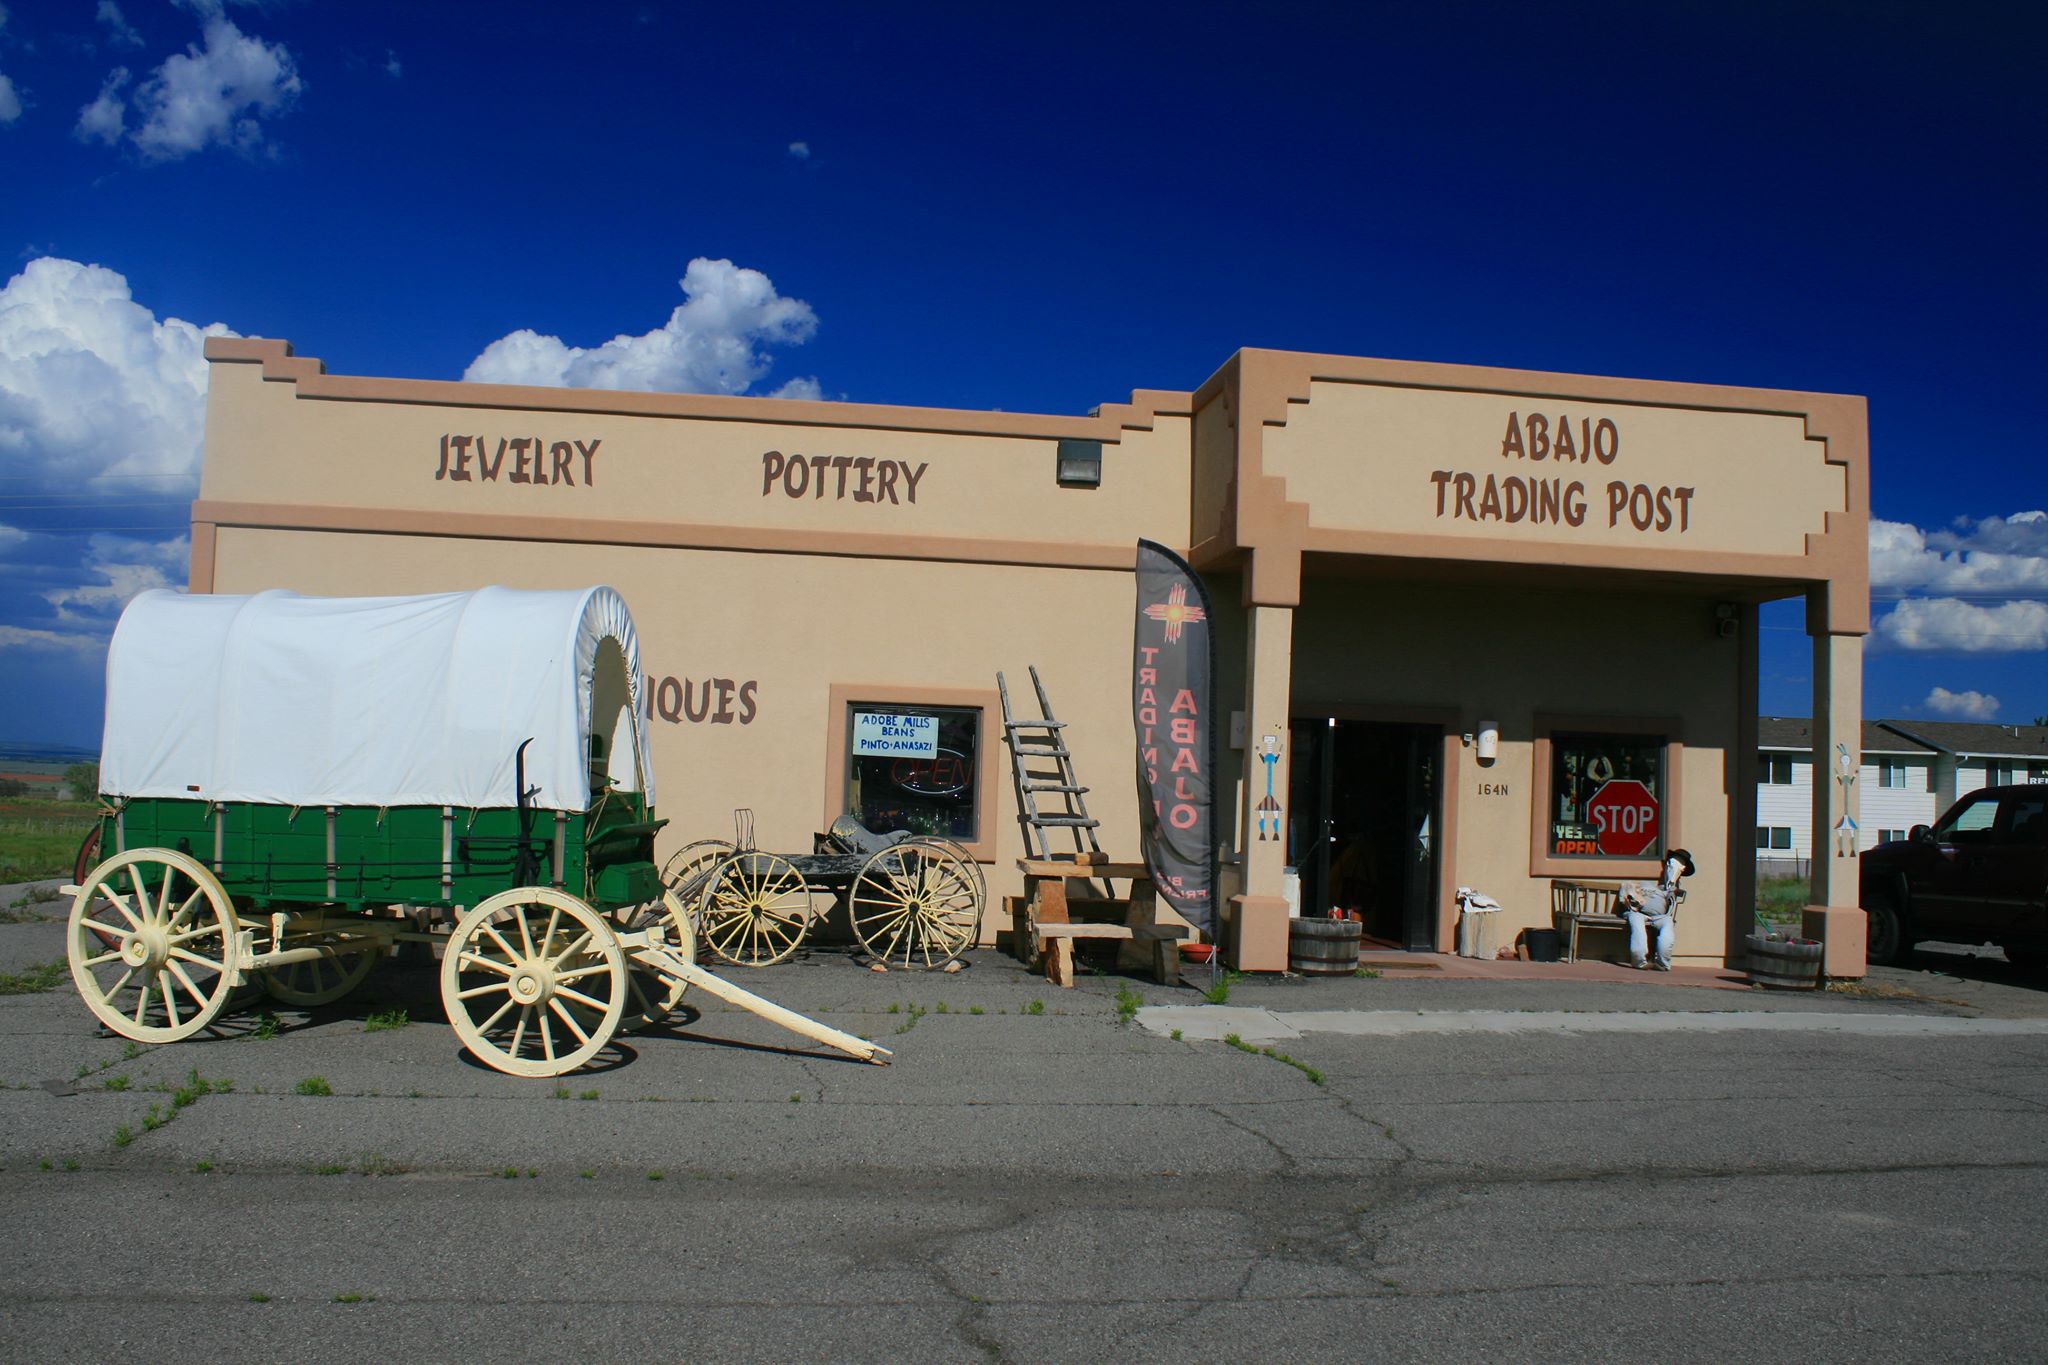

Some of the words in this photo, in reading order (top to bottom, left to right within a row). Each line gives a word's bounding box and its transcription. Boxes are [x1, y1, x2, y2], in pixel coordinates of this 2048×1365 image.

[1501, 411, 1619, 465] ABAJO
[435, 433, 602, 487] JEWELRY
[762, 450, 929, 505] POTTERY
[1430, 470, 1587, 527] TRADING
[1607, 481, 1695, 533] POST
[862, 715, 897, 726] ADOBE
[903, 717, 930, 729] MILLS
[881, 727, 915, 738] BEANS
[1478, 783, 1508, 796] 164N
[1593, 805, 1654, 834] STOP
[1555, 825, 1583, 839] YES
[1556, 841, 1597, 855] OPEN
